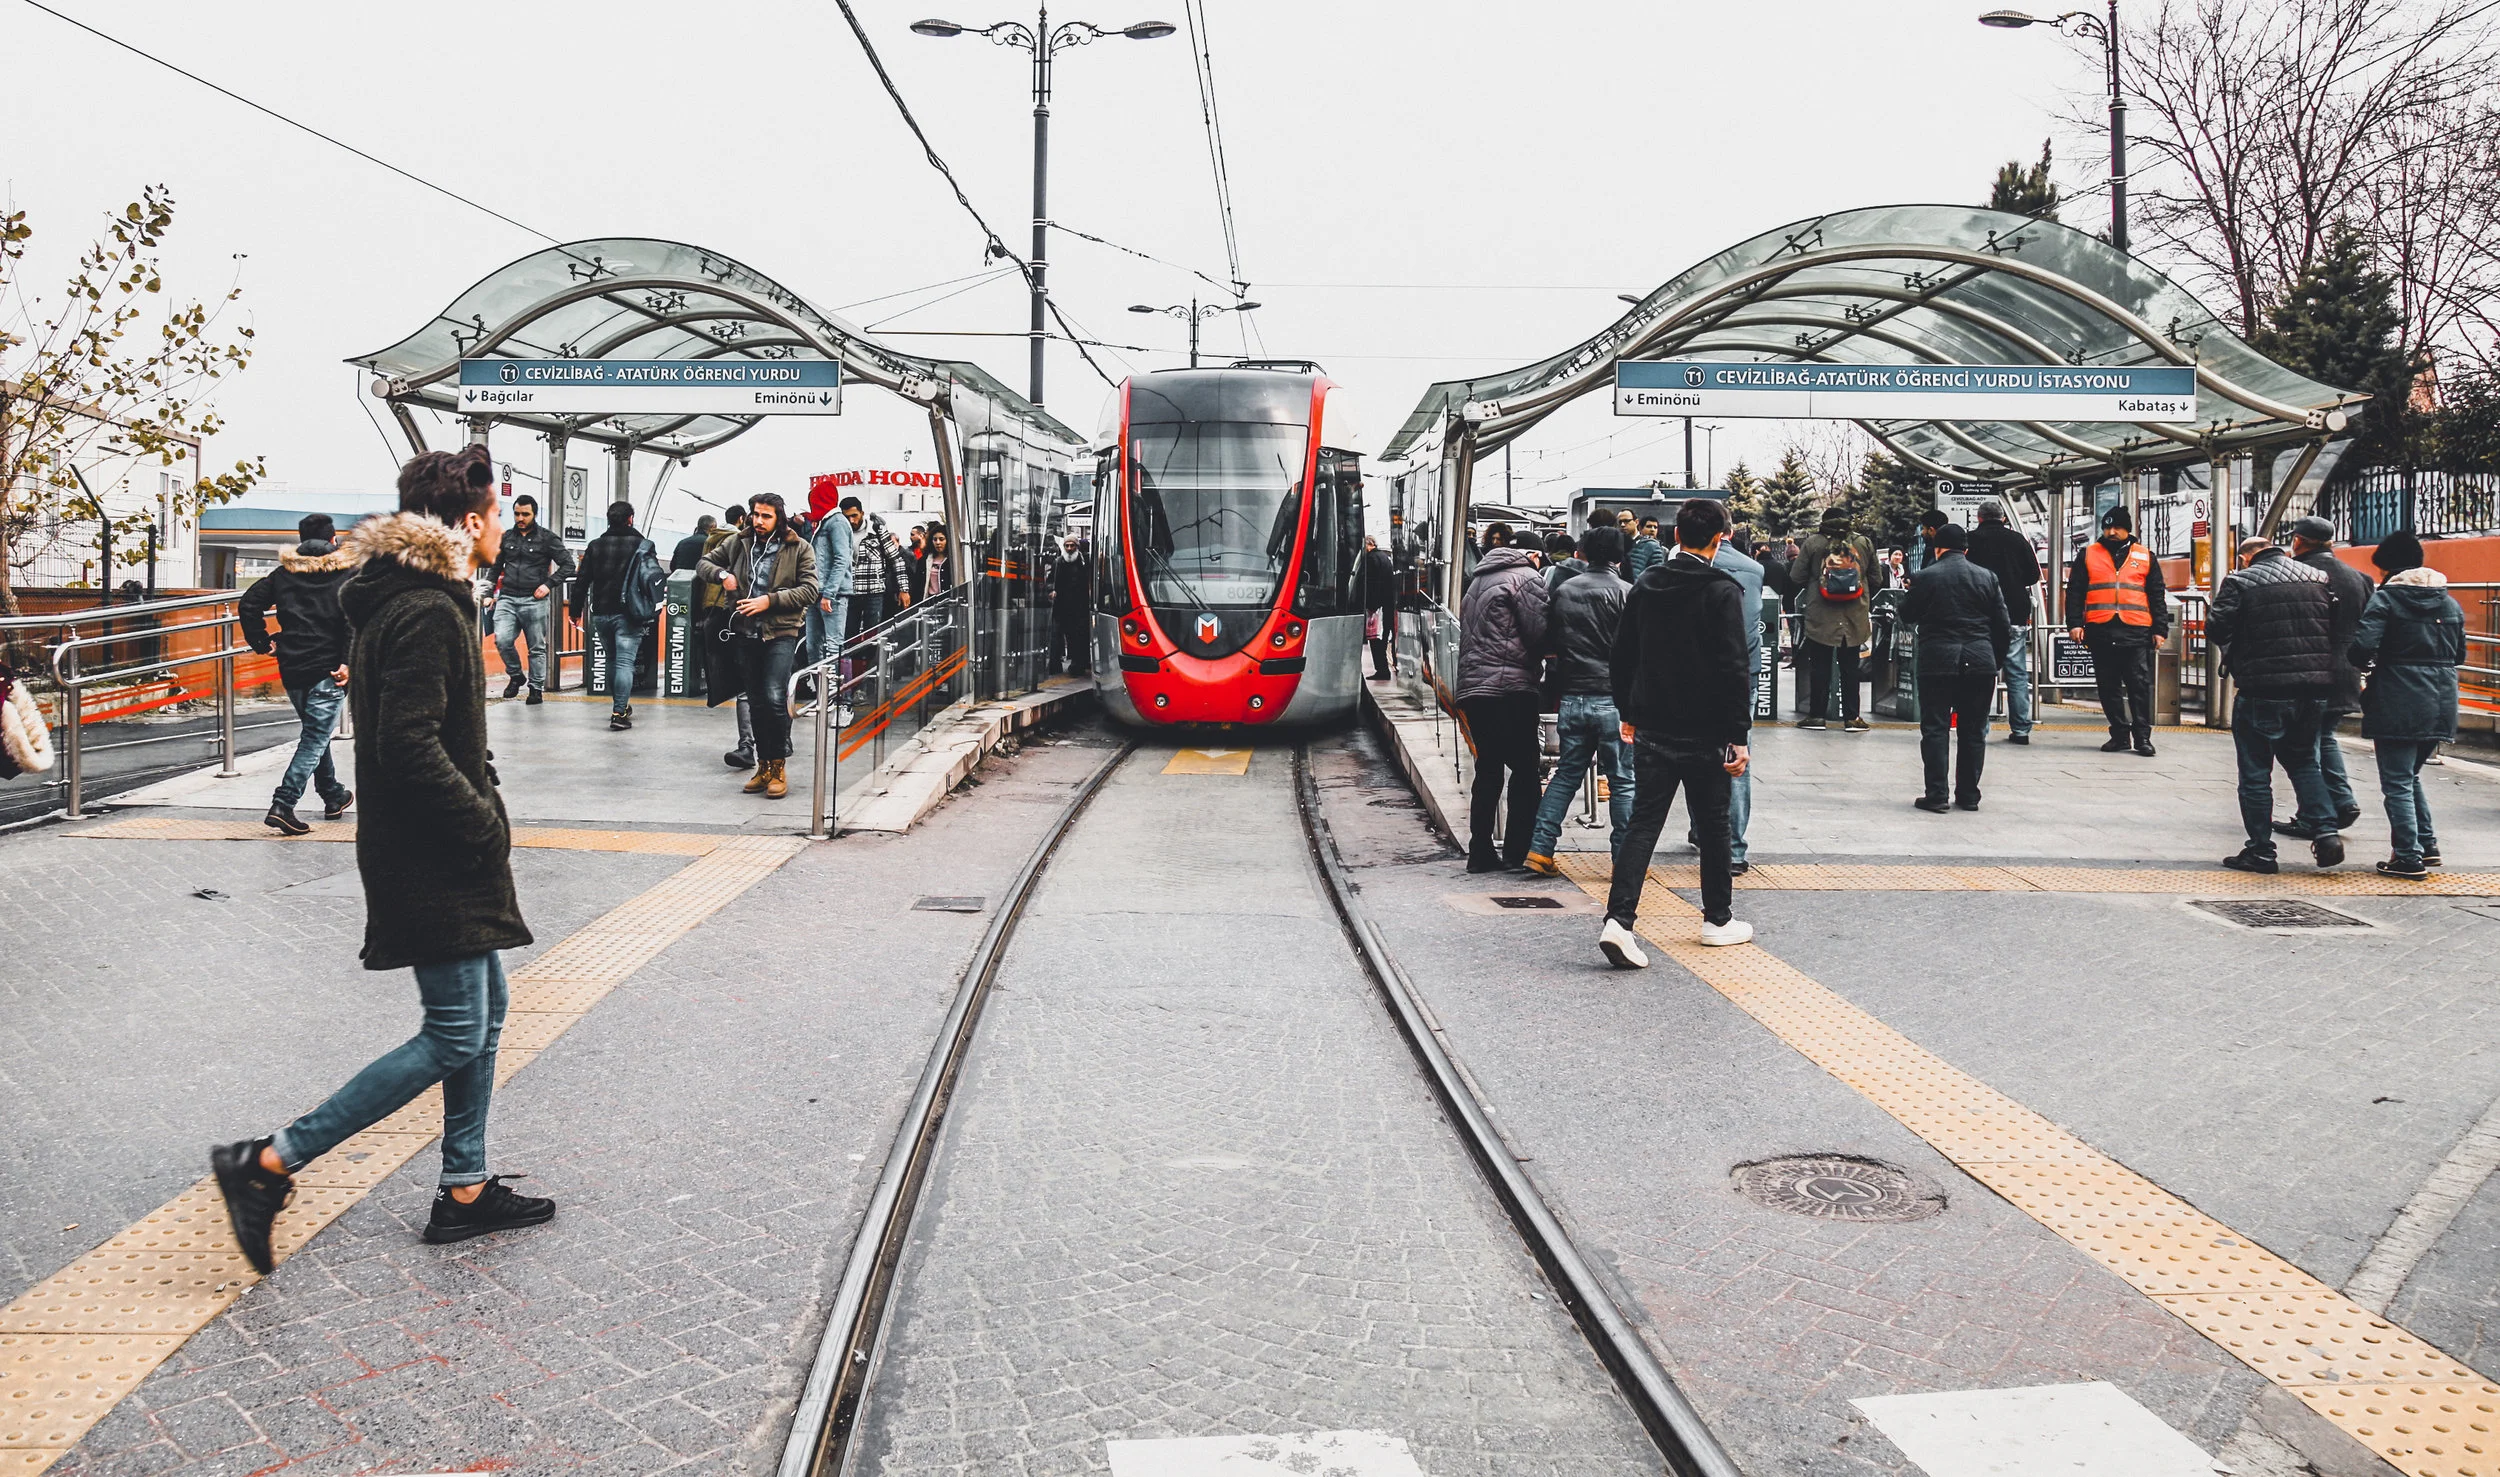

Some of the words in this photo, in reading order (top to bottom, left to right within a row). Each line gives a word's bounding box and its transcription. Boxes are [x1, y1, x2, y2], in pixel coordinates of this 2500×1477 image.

[502, 368, 516, 380] T1
[525, 365, 604, 381] CEVİZLİBAĞ
[616, 365, 679, 380] ATATÜRK
[683, 365, 746, 381] ÖĞRENCİ
[749, 368, 801, 381] YURDU
[1687, 371, 1702, 384] T1
[1716, 367, 1891, 386] CEVİZLİBAĞ-ATATÜRK
[1895, 369, 1970, 387] ÖĞRENCİ
[1974, 374, 2033, 388] YURDU
[2038, 371, 2131, 389] İSTASYONU
[481, 390, 534, 405] Bağcılar
[755, 391, 816, 404] Eminönü
[1637, 393, 1701, 406] Eminönü
[2118, 399, 2177, 415] Kabataş
[668, 626, 685, 694] EMİNEVİM
